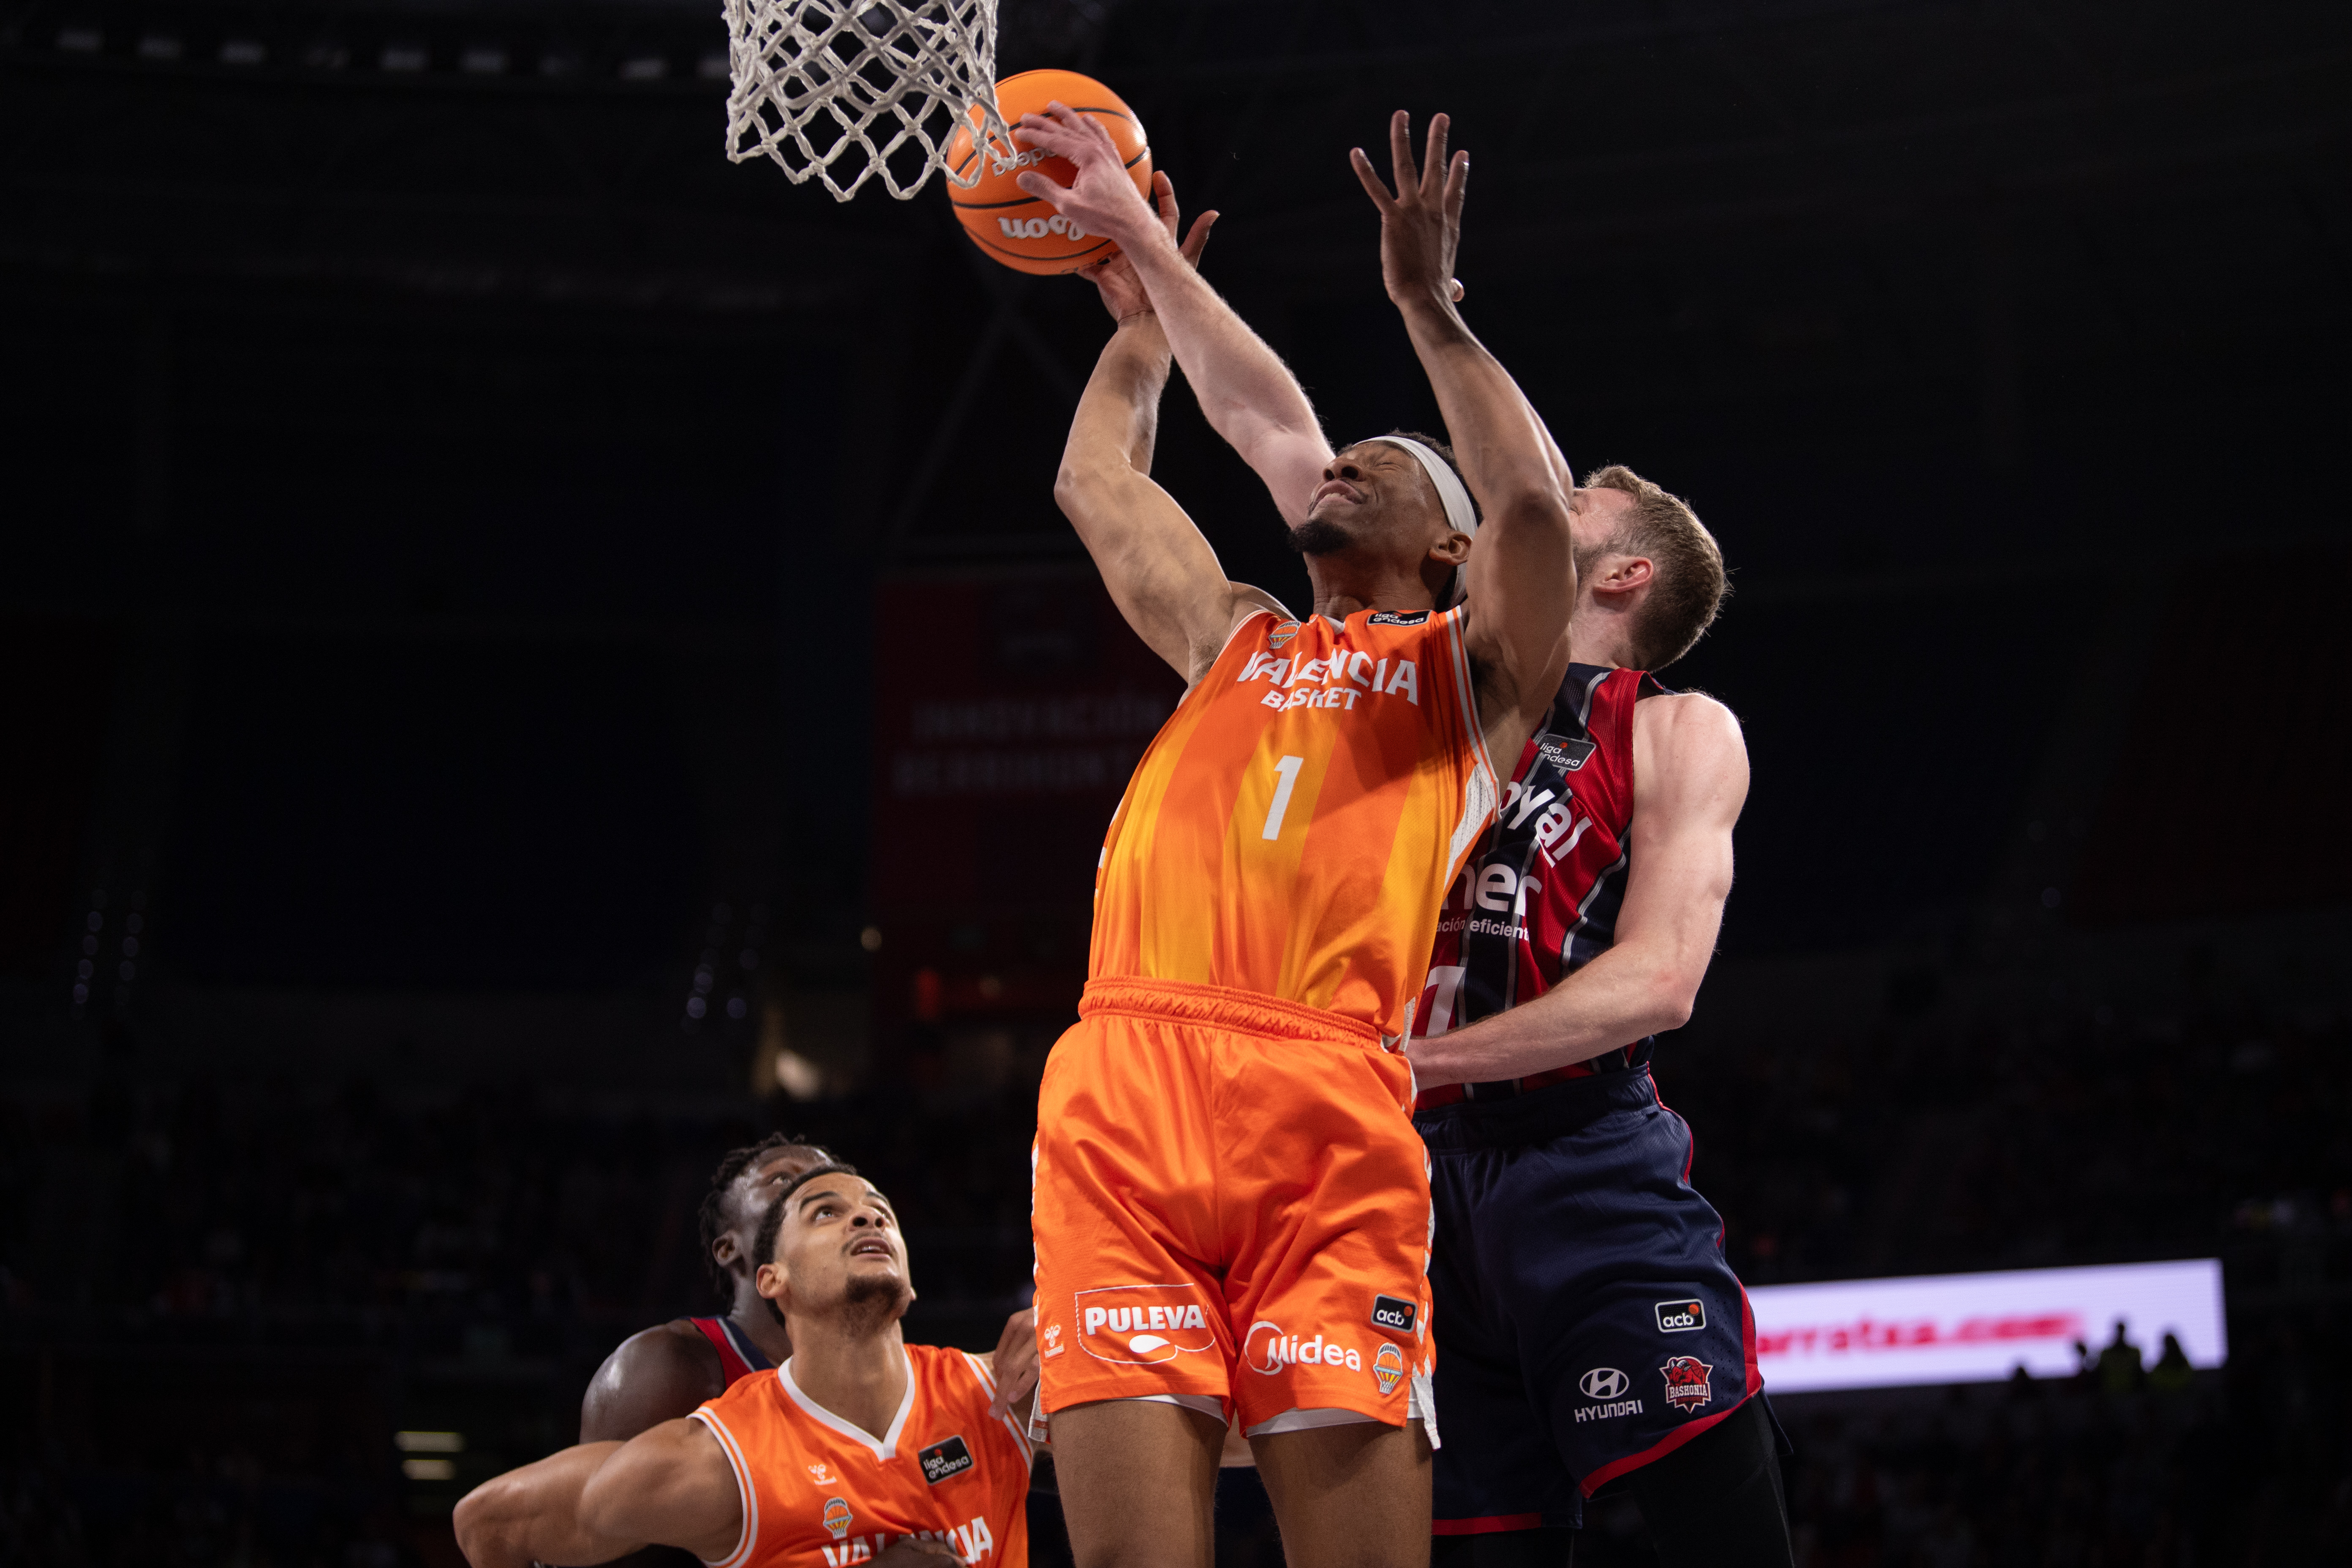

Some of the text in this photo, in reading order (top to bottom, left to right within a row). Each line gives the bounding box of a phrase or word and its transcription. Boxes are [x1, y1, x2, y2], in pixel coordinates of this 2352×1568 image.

[1236, 648, 1418, 706] VALENCIA
[1260, 687, 1362, 712] BASKET
[1540, 743, 1562, 754] liga
[1262, 755, 1304, 841] 1
[1085, 1304, 1206, 1336] PULEVA
[1376, 1309, 1405, 1326] acb
[1663, 1312, 1694, 1328] acb
[1265, 1334, 1361, 1372] Midea
[1669, 1384, 1708, 1399] BASKONIA
[1574, 1399, 1643, 1423] HYUNDAI
[923, 1456, 944, 1470] liga
[821, 1515, 994, 1567] VALCIA
